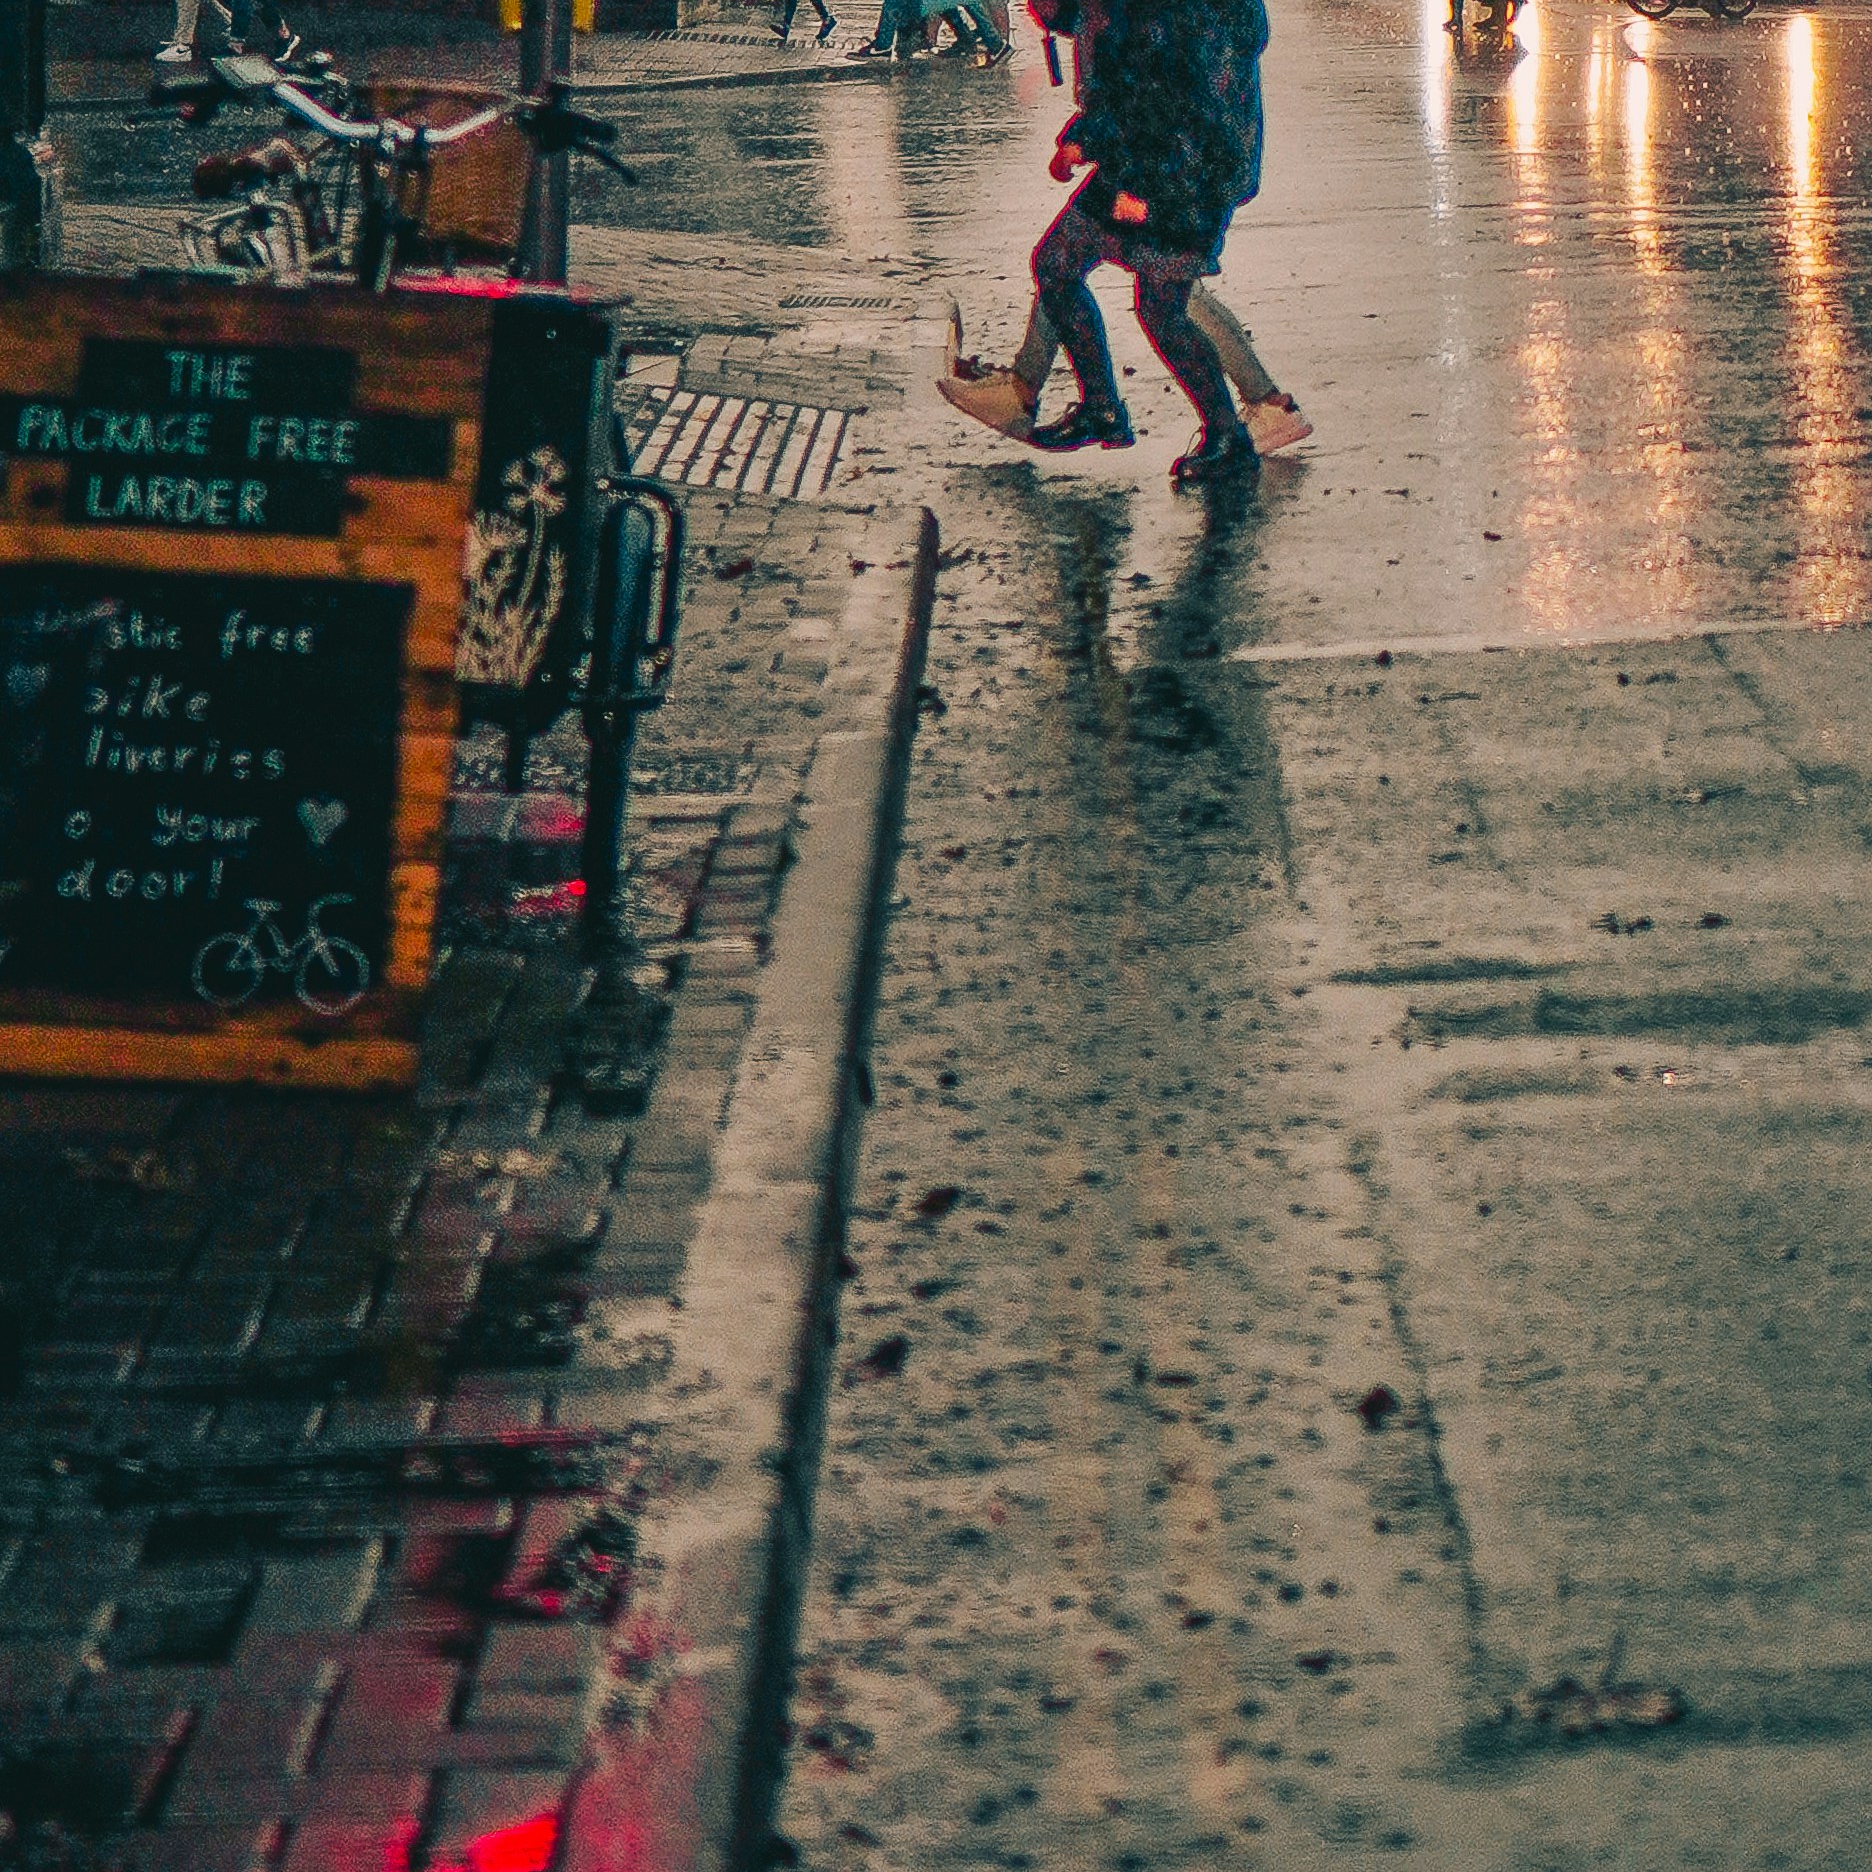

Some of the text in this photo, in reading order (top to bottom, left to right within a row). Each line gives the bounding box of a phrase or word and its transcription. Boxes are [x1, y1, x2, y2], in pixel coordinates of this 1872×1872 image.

[165, 350, 254, 400] THE
[18, 405, 360, 464] PACKAGE FREE
[86, 474, 267, 525] LARDER
[219, 608, 316, 658] free
[152, 804, 262, 847] your
